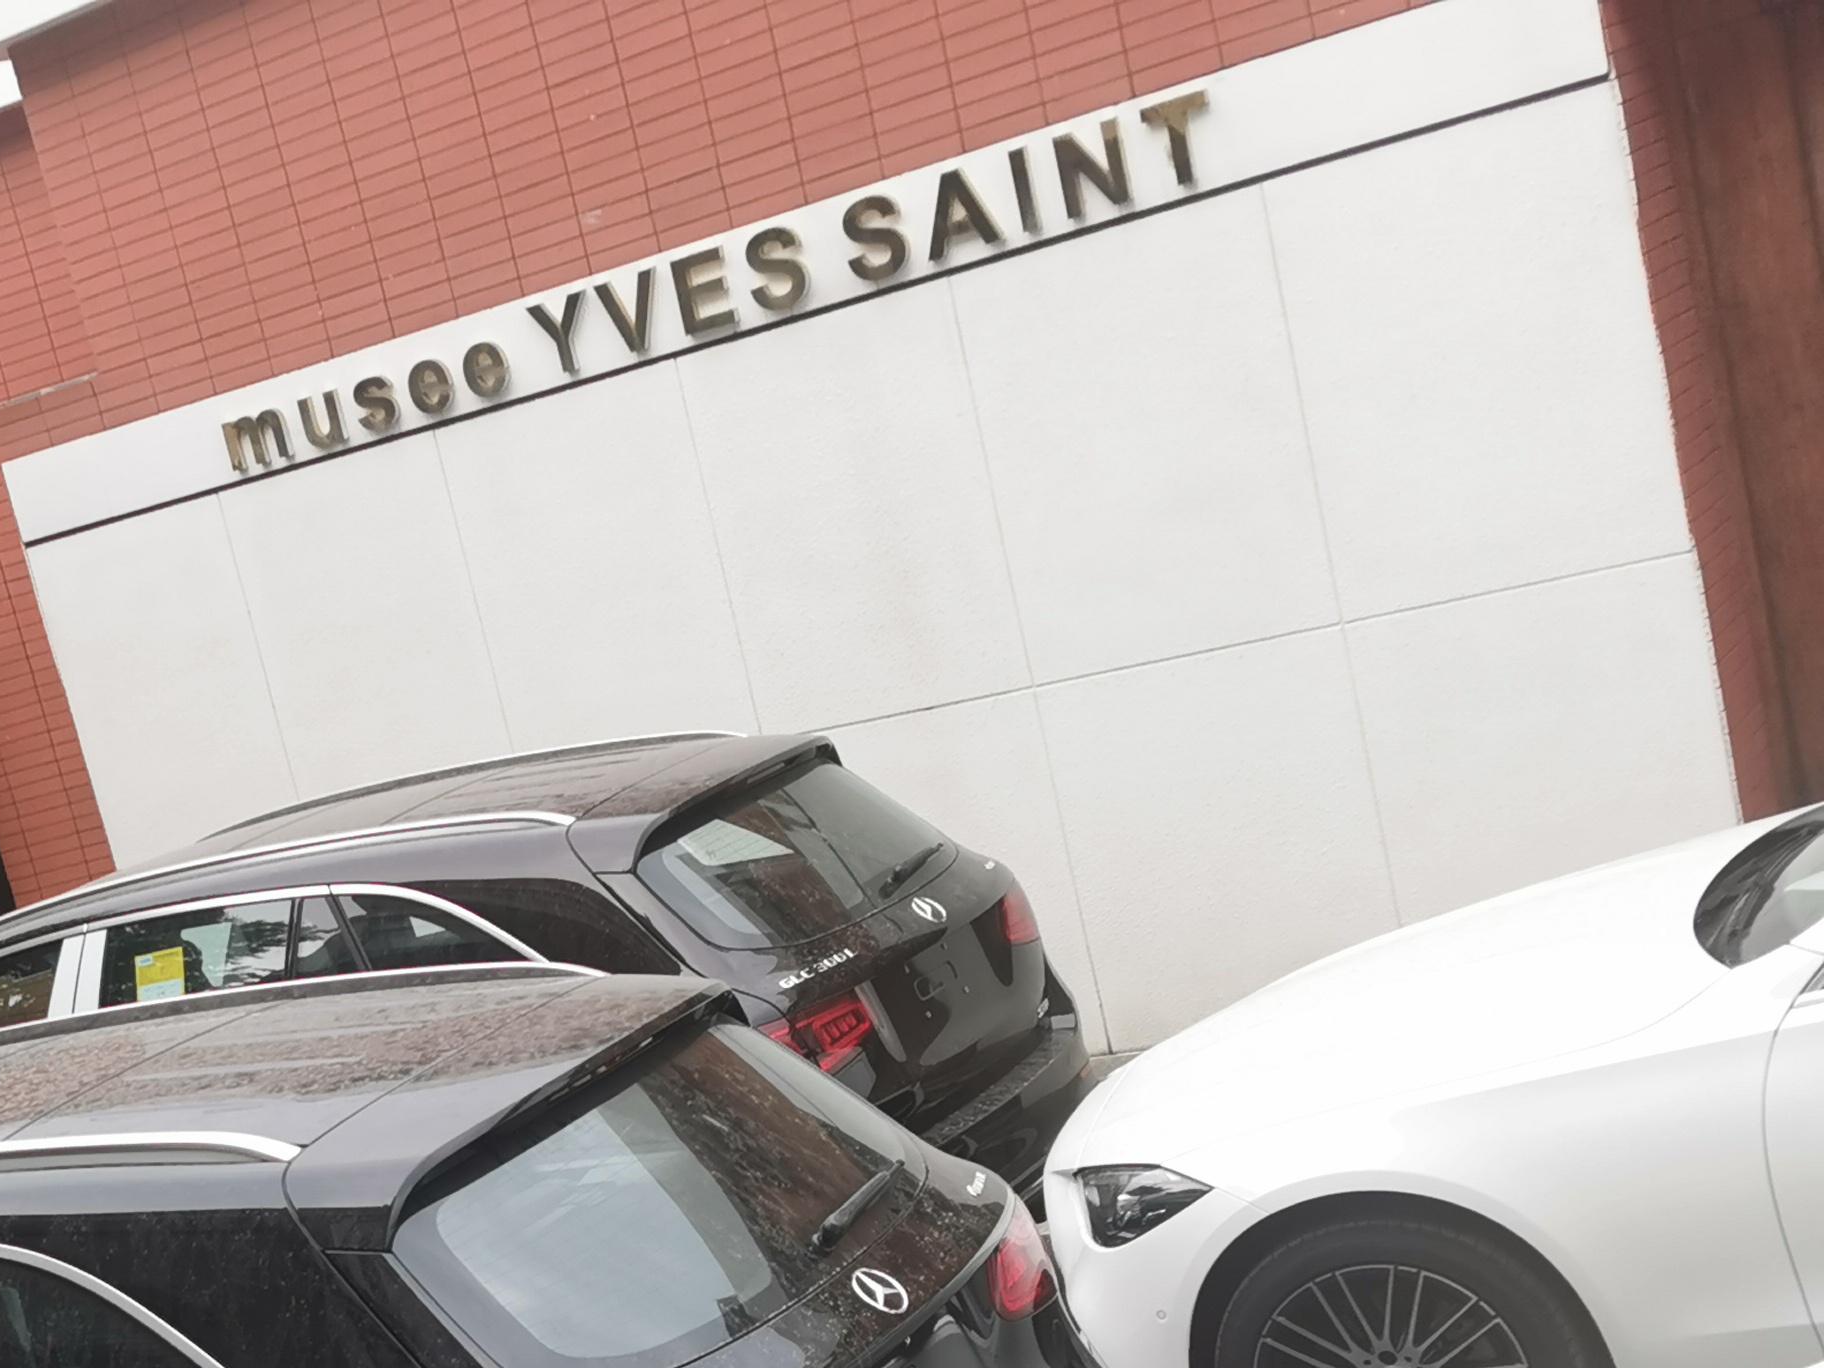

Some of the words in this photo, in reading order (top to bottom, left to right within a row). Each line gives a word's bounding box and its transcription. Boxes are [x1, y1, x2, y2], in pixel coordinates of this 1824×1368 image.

[526, 227, 811, 373] YVES
[841, 89, 1209, 282] SAINT
[778, 966, 815, 989] GLC
